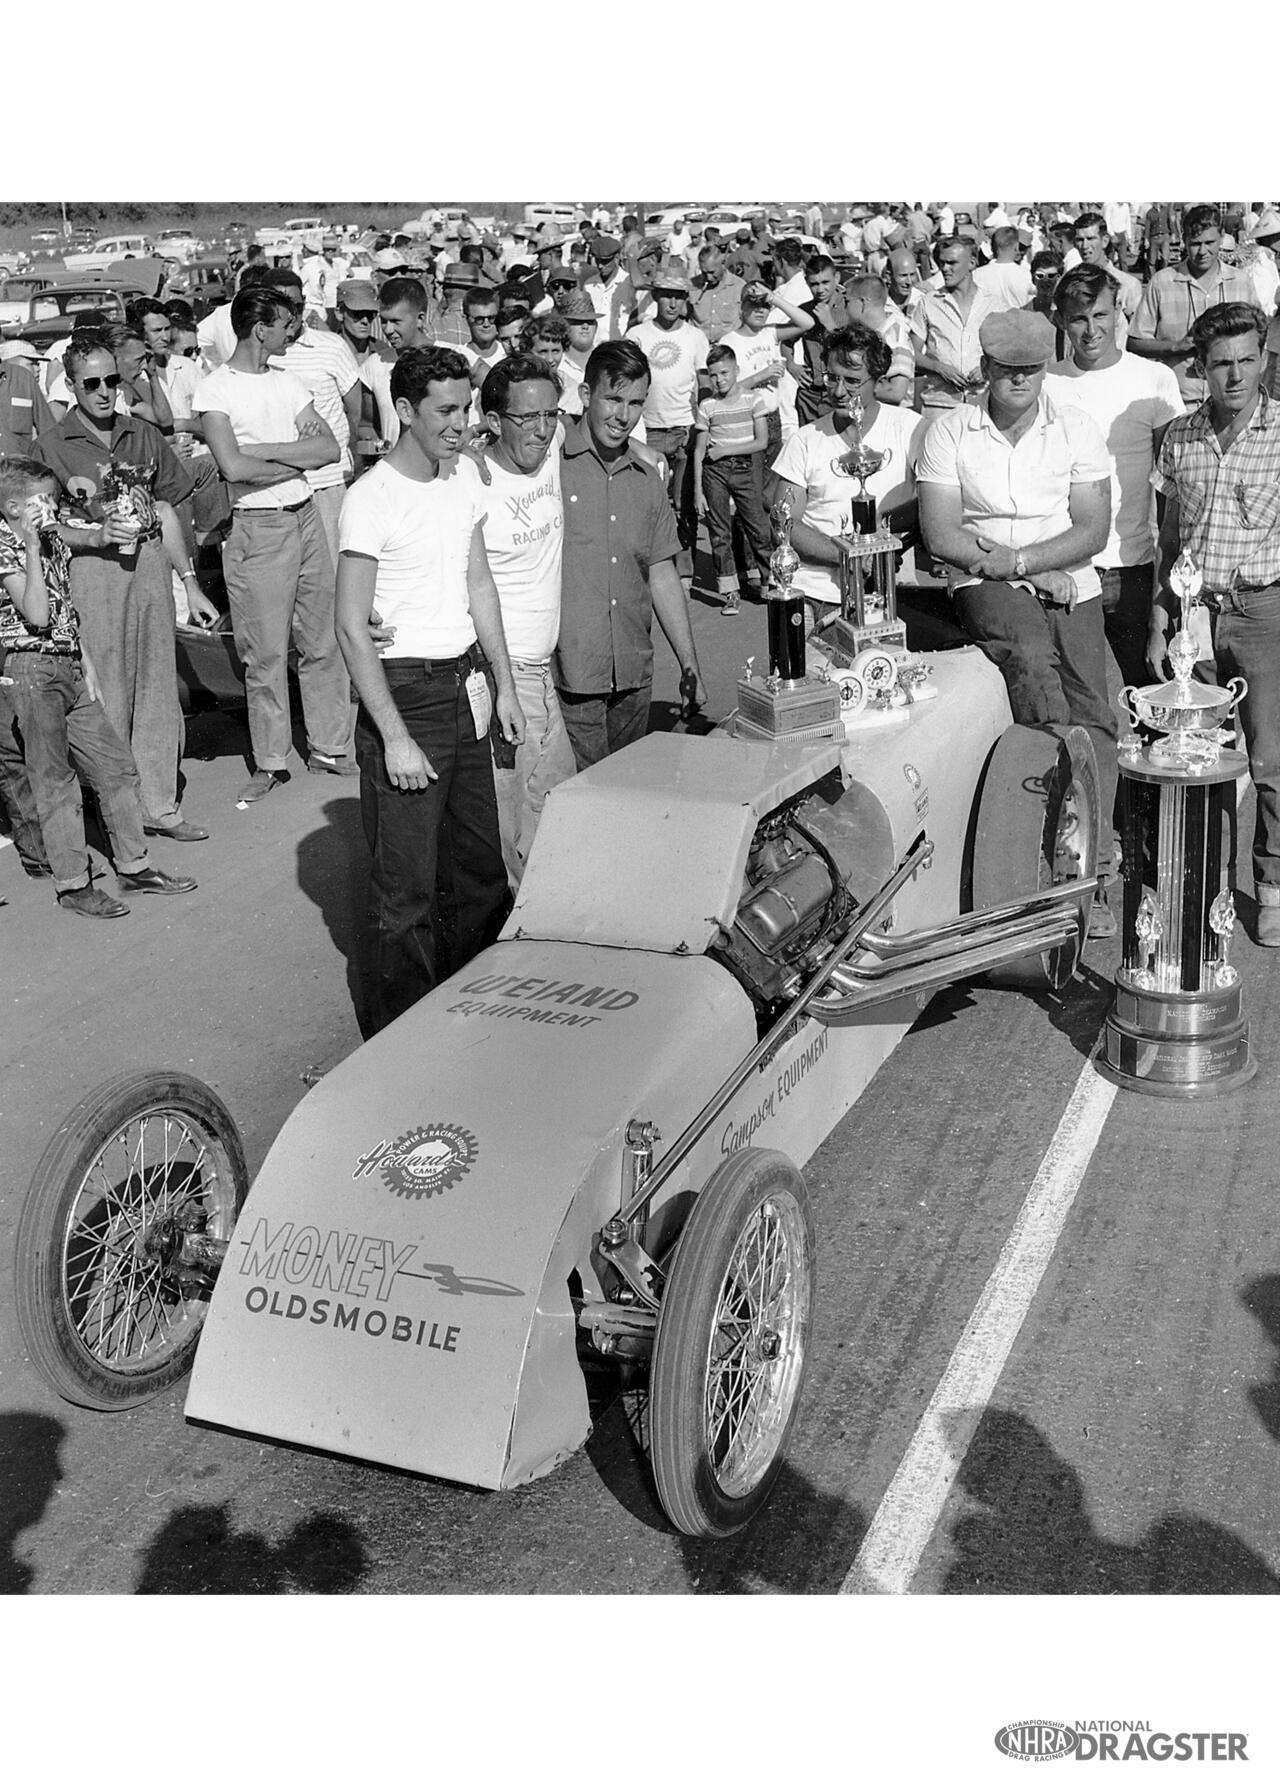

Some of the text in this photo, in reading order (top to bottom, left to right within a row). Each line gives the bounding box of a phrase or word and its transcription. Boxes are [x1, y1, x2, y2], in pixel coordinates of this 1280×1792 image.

[512, 522, 551, 546] RACING
[459, 974, 640, 1011] WEIAND
[446, 1000, 602, 1028] EQUIPMENT
[721, 1026, 829, 1157] Sampson EQUIPMENT
[396, 1133, 421, 1155] POWER
[429, 1130, 457, 1140] RACING
[413, 1167, 438, 1175] CAMS
[239, 1217, 419, 1302] MONEY
[244, 1285, 462, 1353] OLDSMOBILE
